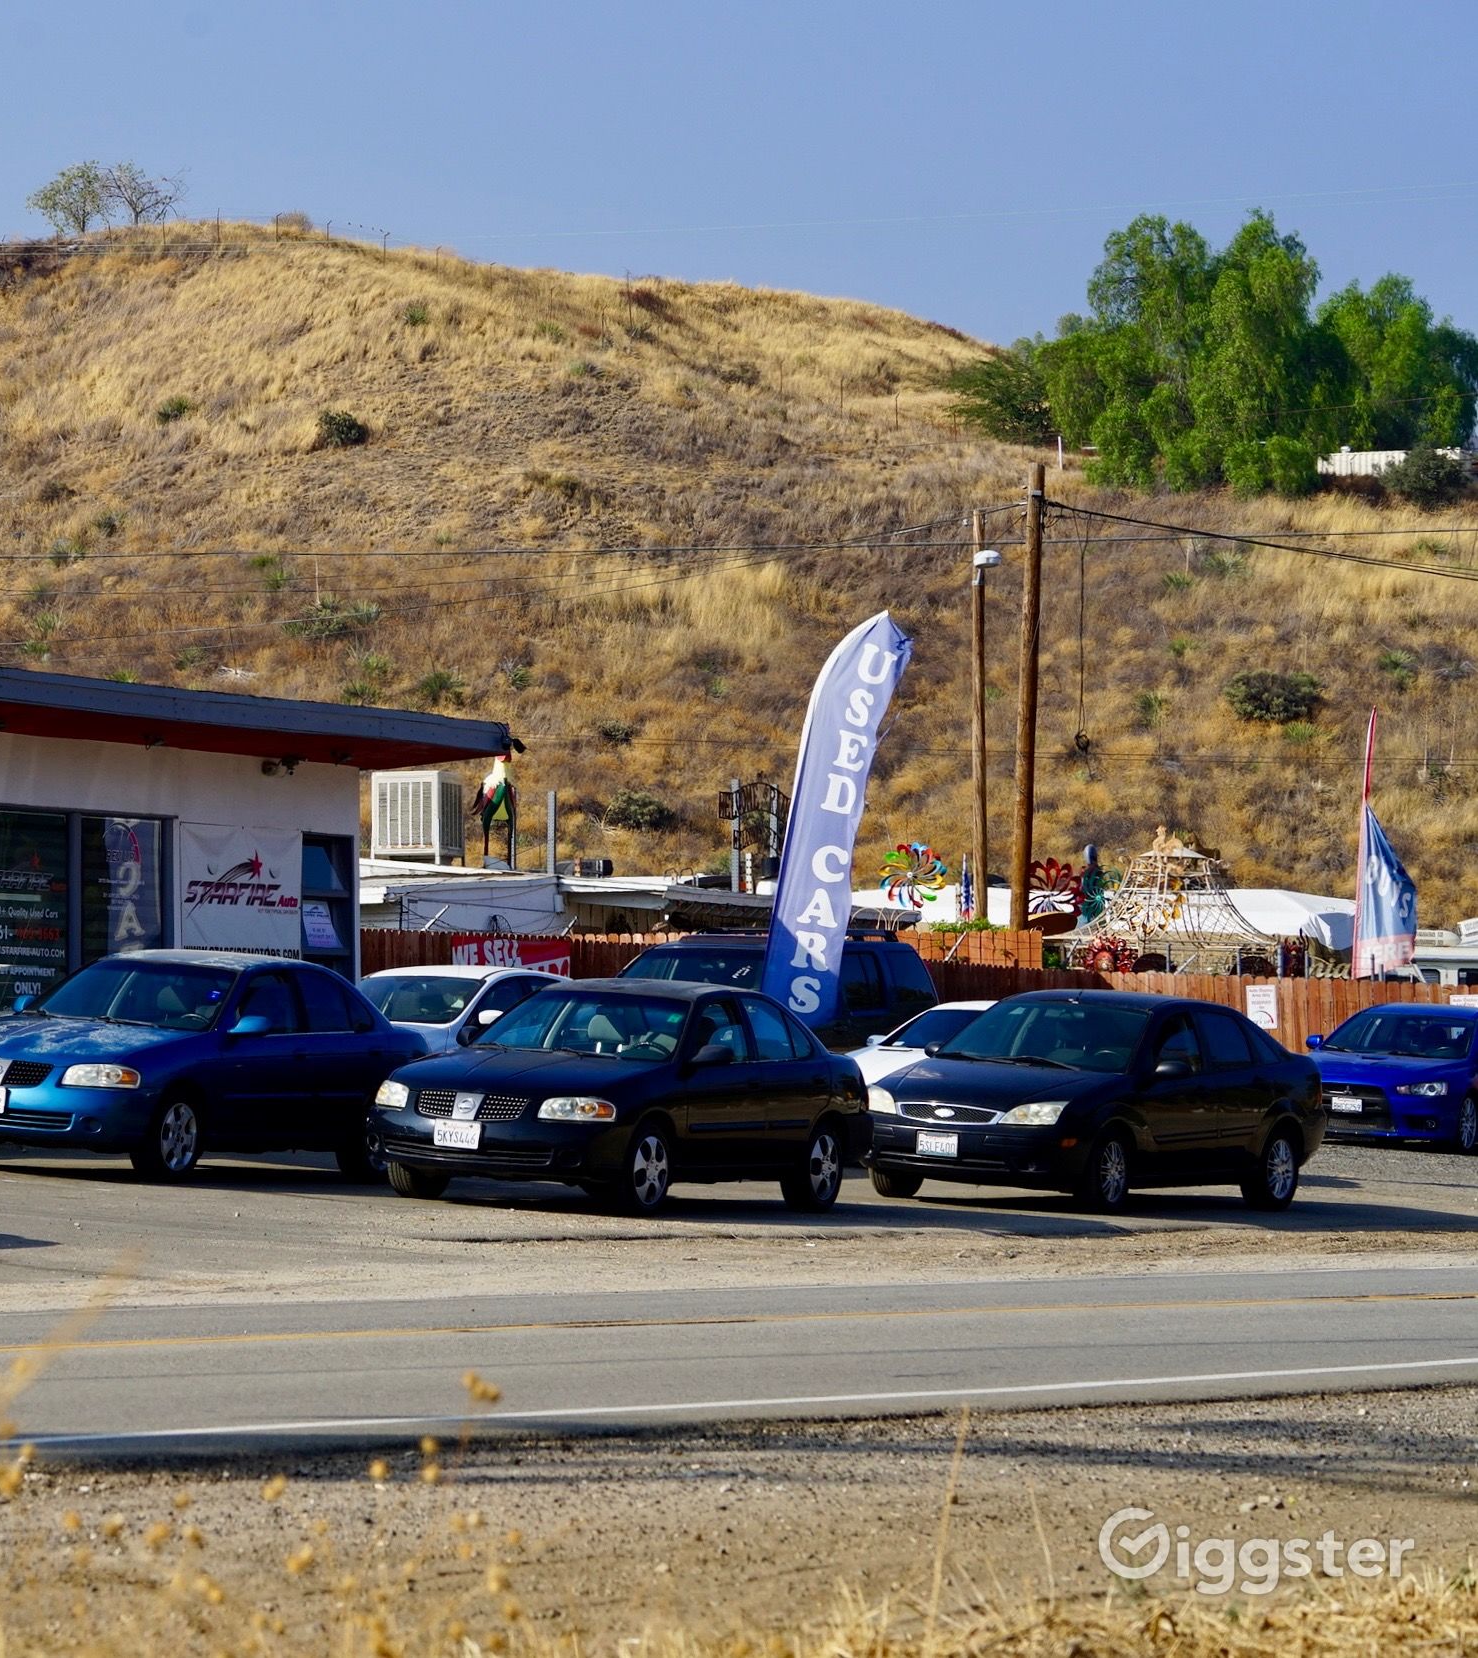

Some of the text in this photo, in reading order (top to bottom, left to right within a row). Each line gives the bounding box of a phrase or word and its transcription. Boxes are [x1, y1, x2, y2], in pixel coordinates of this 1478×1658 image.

[789, 643, 897, 1014] USED CARS
[184, 880, 299, 908] STARFIRE Auto
[8, 906, 29, 919] Quality
[45, 908, 59, 919] Cars
[452, 943, 479, 966] WE
[483, 939, 523, 968] SELL
[14, 981, 41, 996] ONLY!
[437, 1129, 476, 1145] 5KYS446
[919, 1140, 956, 1153] 5SLF400
